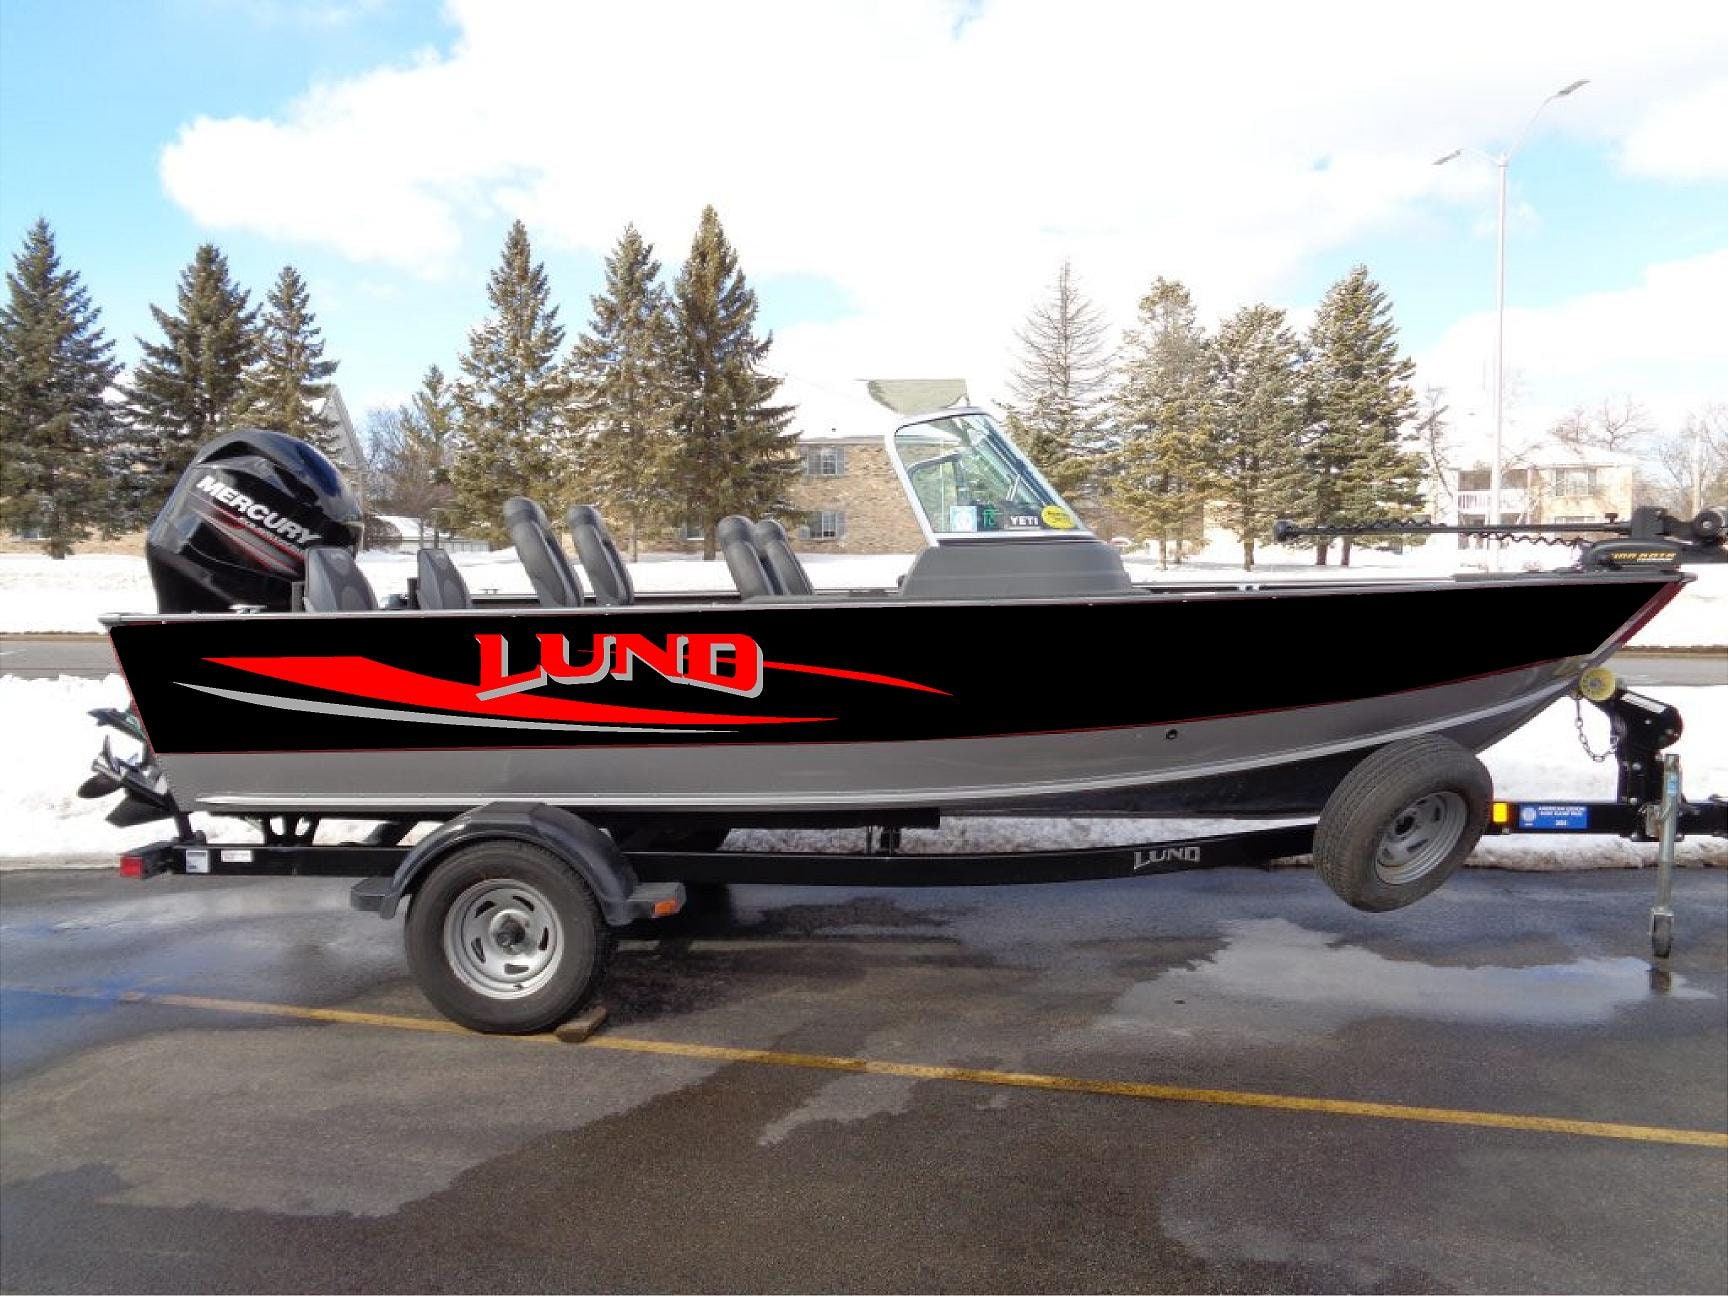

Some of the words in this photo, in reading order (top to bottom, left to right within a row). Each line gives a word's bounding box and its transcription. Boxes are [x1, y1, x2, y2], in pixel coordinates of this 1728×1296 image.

[196, 475, 321, 544] MERCURY
[1010, 515, 1039, 526] YETI
[474, 633, 764, 699] LUND
[1134, 846, 1201, 870] LUND
